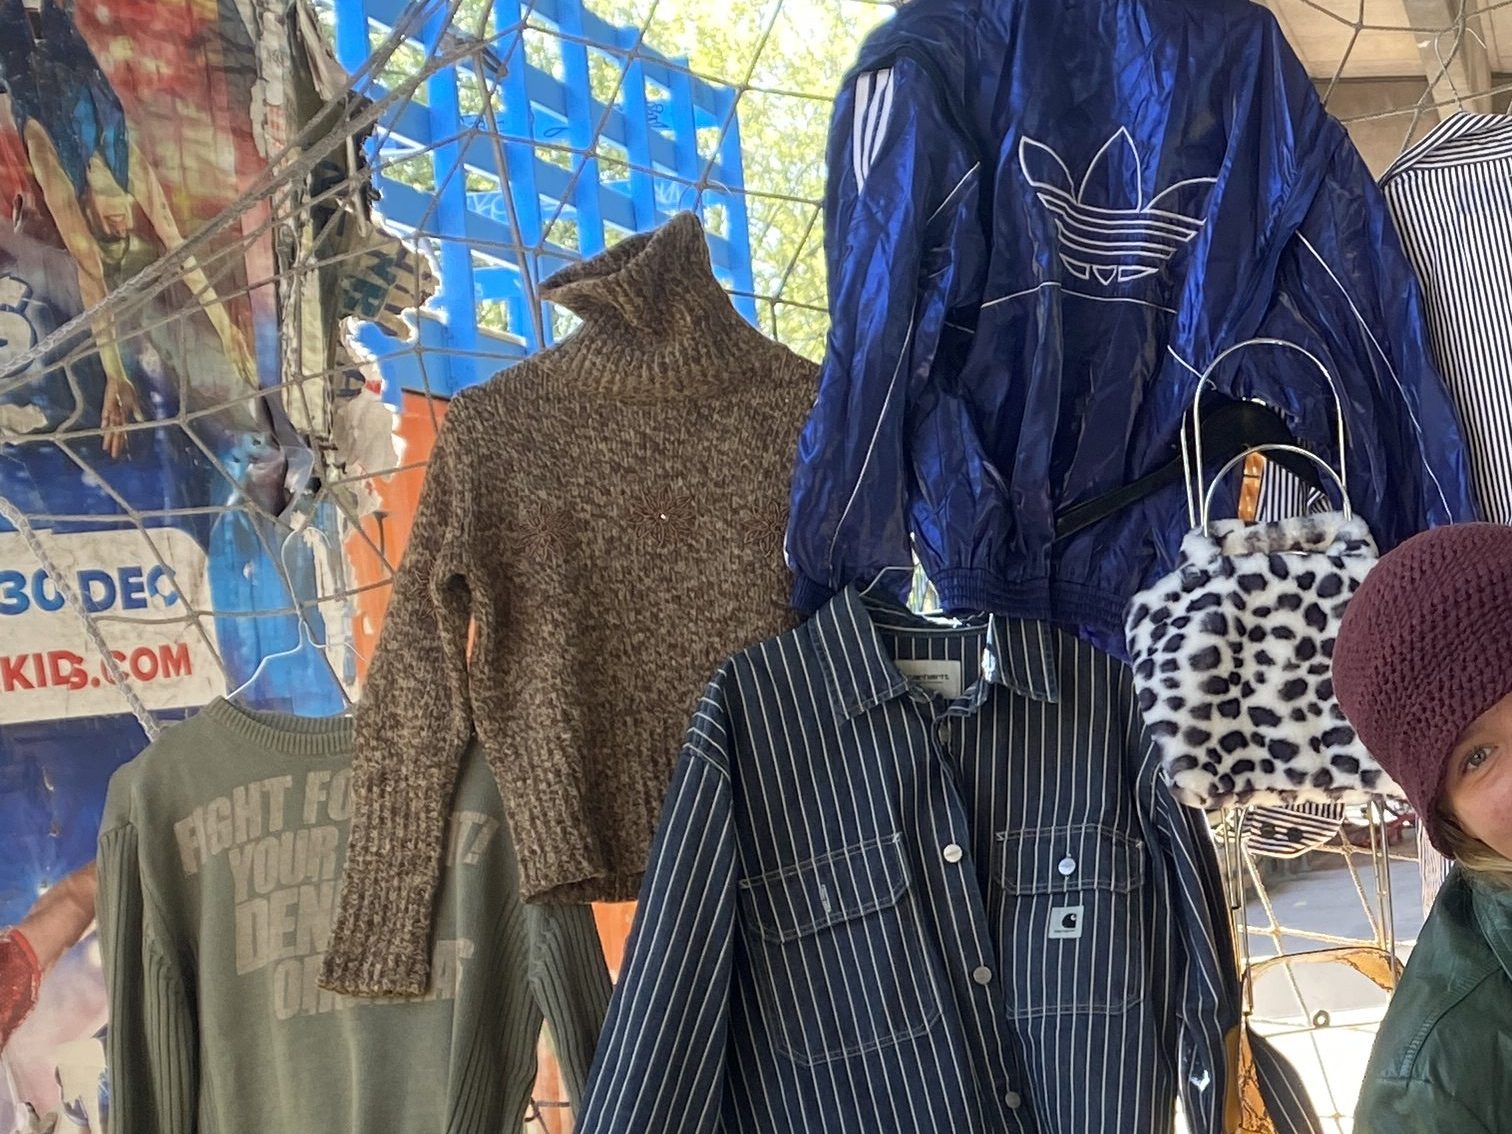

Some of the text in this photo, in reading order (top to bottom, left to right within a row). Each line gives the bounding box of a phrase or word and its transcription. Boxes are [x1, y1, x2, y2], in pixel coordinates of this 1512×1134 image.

[75, 563, 179, 613] DEC
[0, 642, 193, 692] KIDS.COM
[302, 767, 354, 824] FO
[229, 826, 339, 902] YOUR
